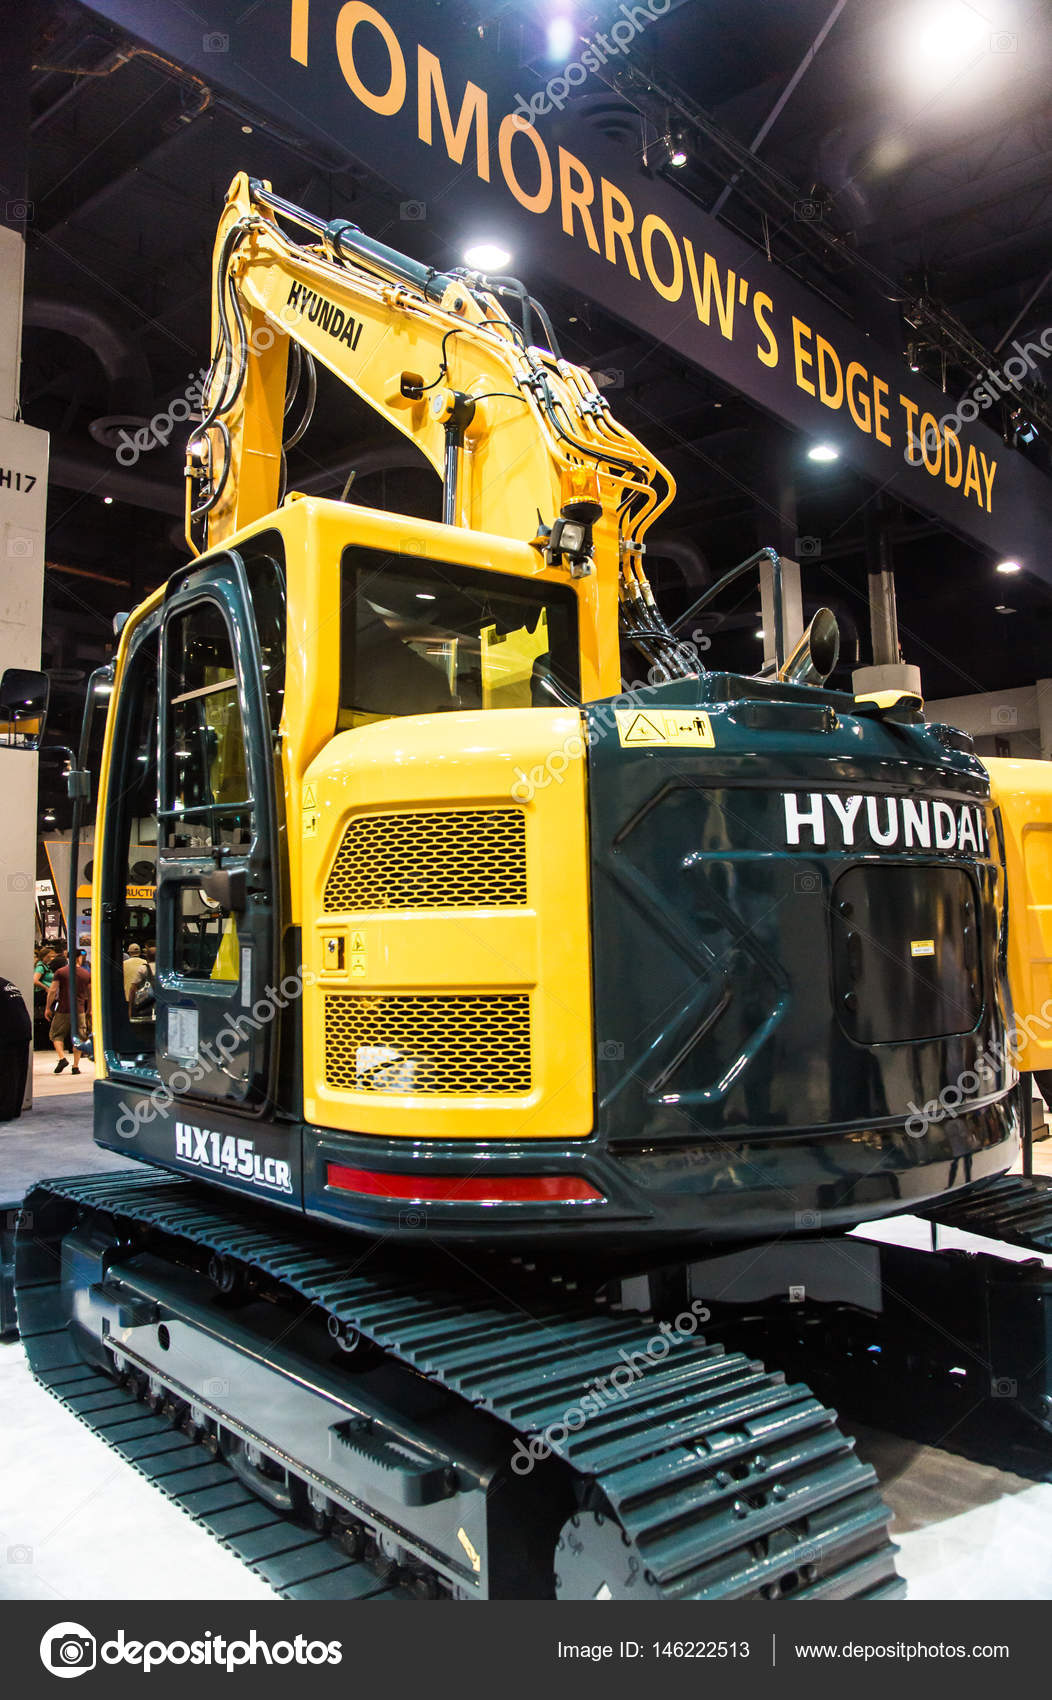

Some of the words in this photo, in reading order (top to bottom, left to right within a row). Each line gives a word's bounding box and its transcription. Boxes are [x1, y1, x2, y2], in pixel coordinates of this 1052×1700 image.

[287, 280, 364, 351] HYUNDAI
[791, 315, 892, 447] EDGE
[900, 393, 998, 513] TODAY
[783, 793, 985, 853] HYUNDAI
